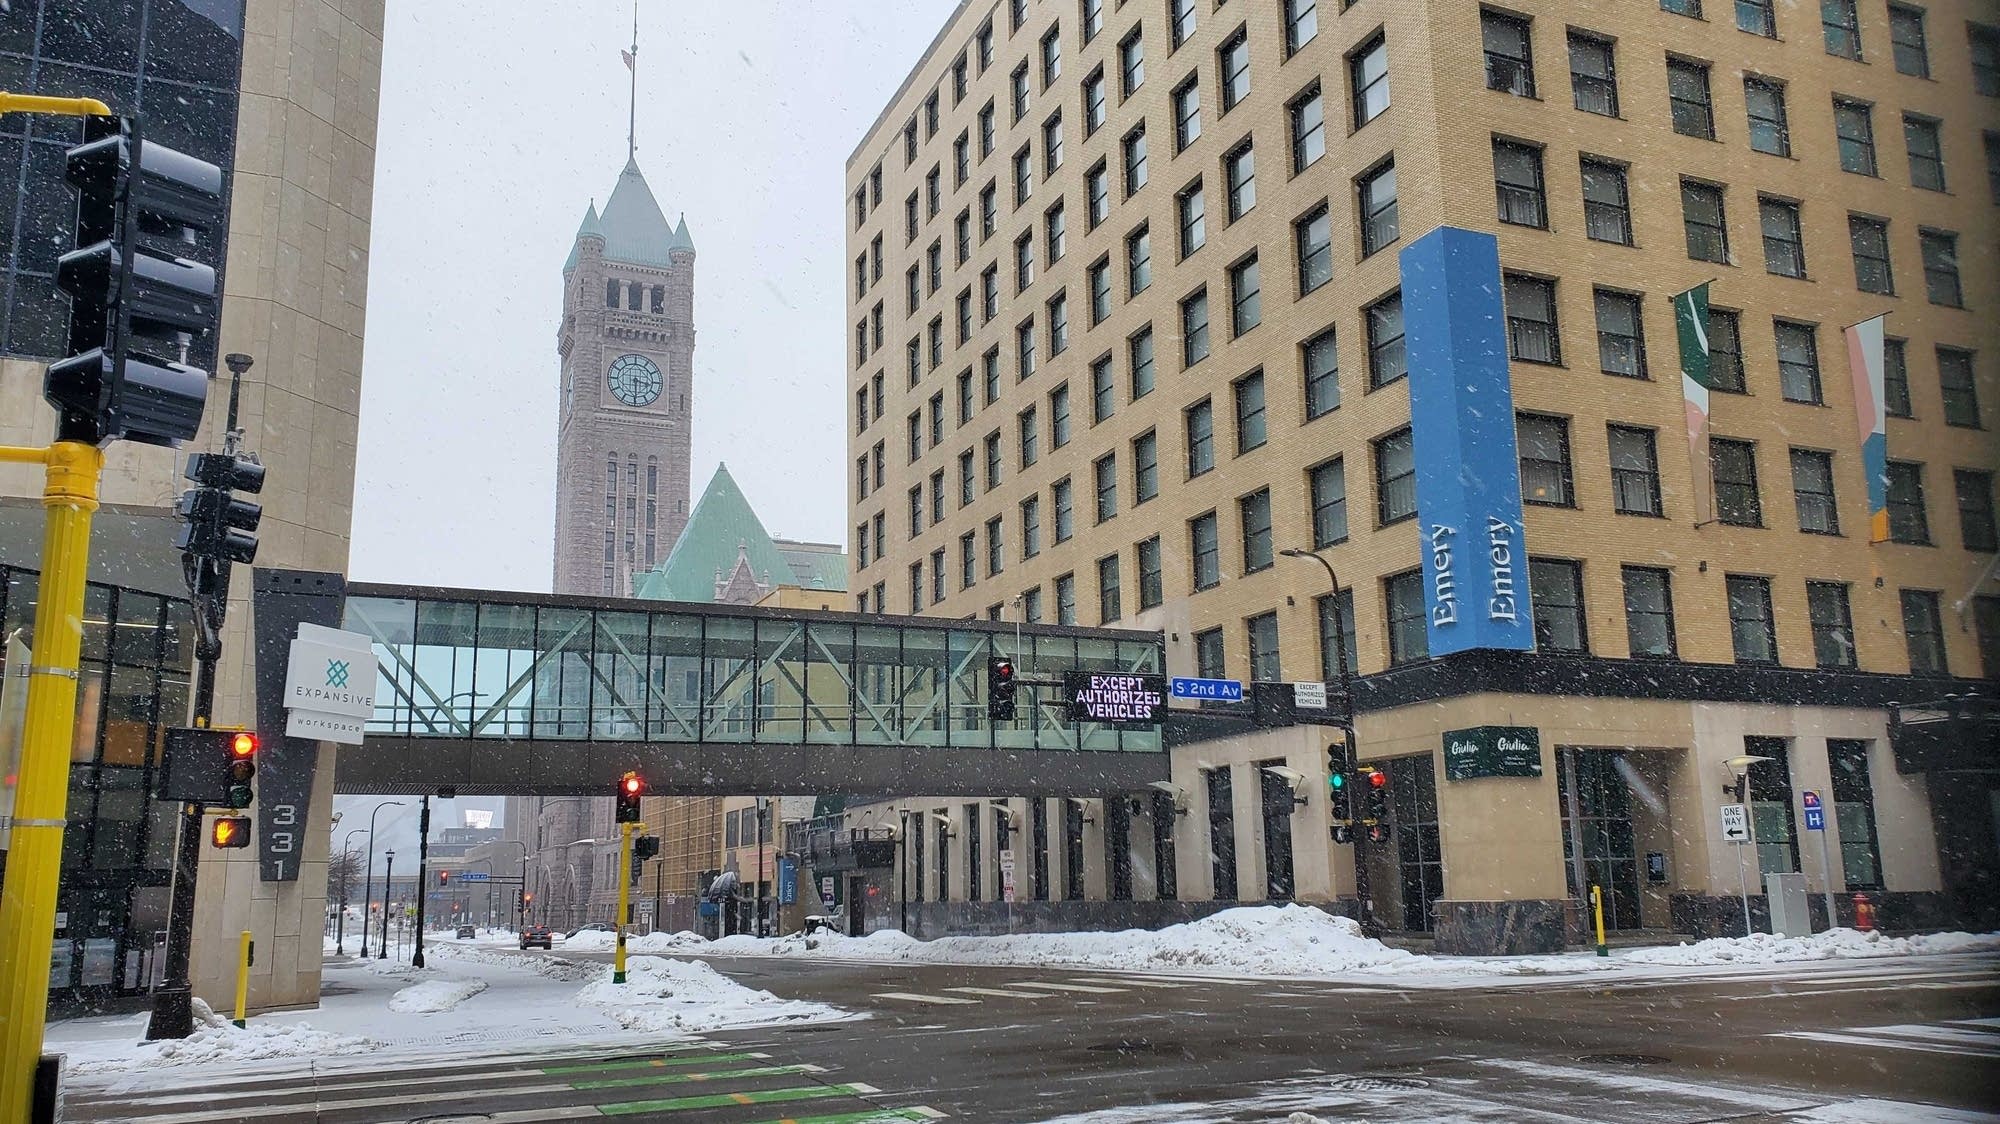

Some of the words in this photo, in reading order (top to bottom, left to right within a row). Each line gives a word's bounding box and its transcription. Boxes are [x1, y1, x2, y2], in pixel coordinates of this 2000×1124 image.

[1432, 524, 1456, 626] Emery
[1490, 516, 1514, 619] Emery
[1091, 676, 1143, 690] EXCEPT
[1176, 682, 1184, 694] S
[1190, 683, 1215, 695] 2nd
[1221, 686, 1239, 697] Av
[296, 686, 372, 706] EXPANSIVE
[1076, 690, 1161, 705] AUTHORIZED
[1087, 704, 1151, 718] VEHICLES
[297, 719, 360, 732] workspace
[1451, 740, 1479, 755] Giulia
[1497, 737, 1530, 752] Giulia
[1724, 806, 1740, 816] ONE
[1725, 817, 1741, 826] WAY
[1809, 812, 1820, 826] H
